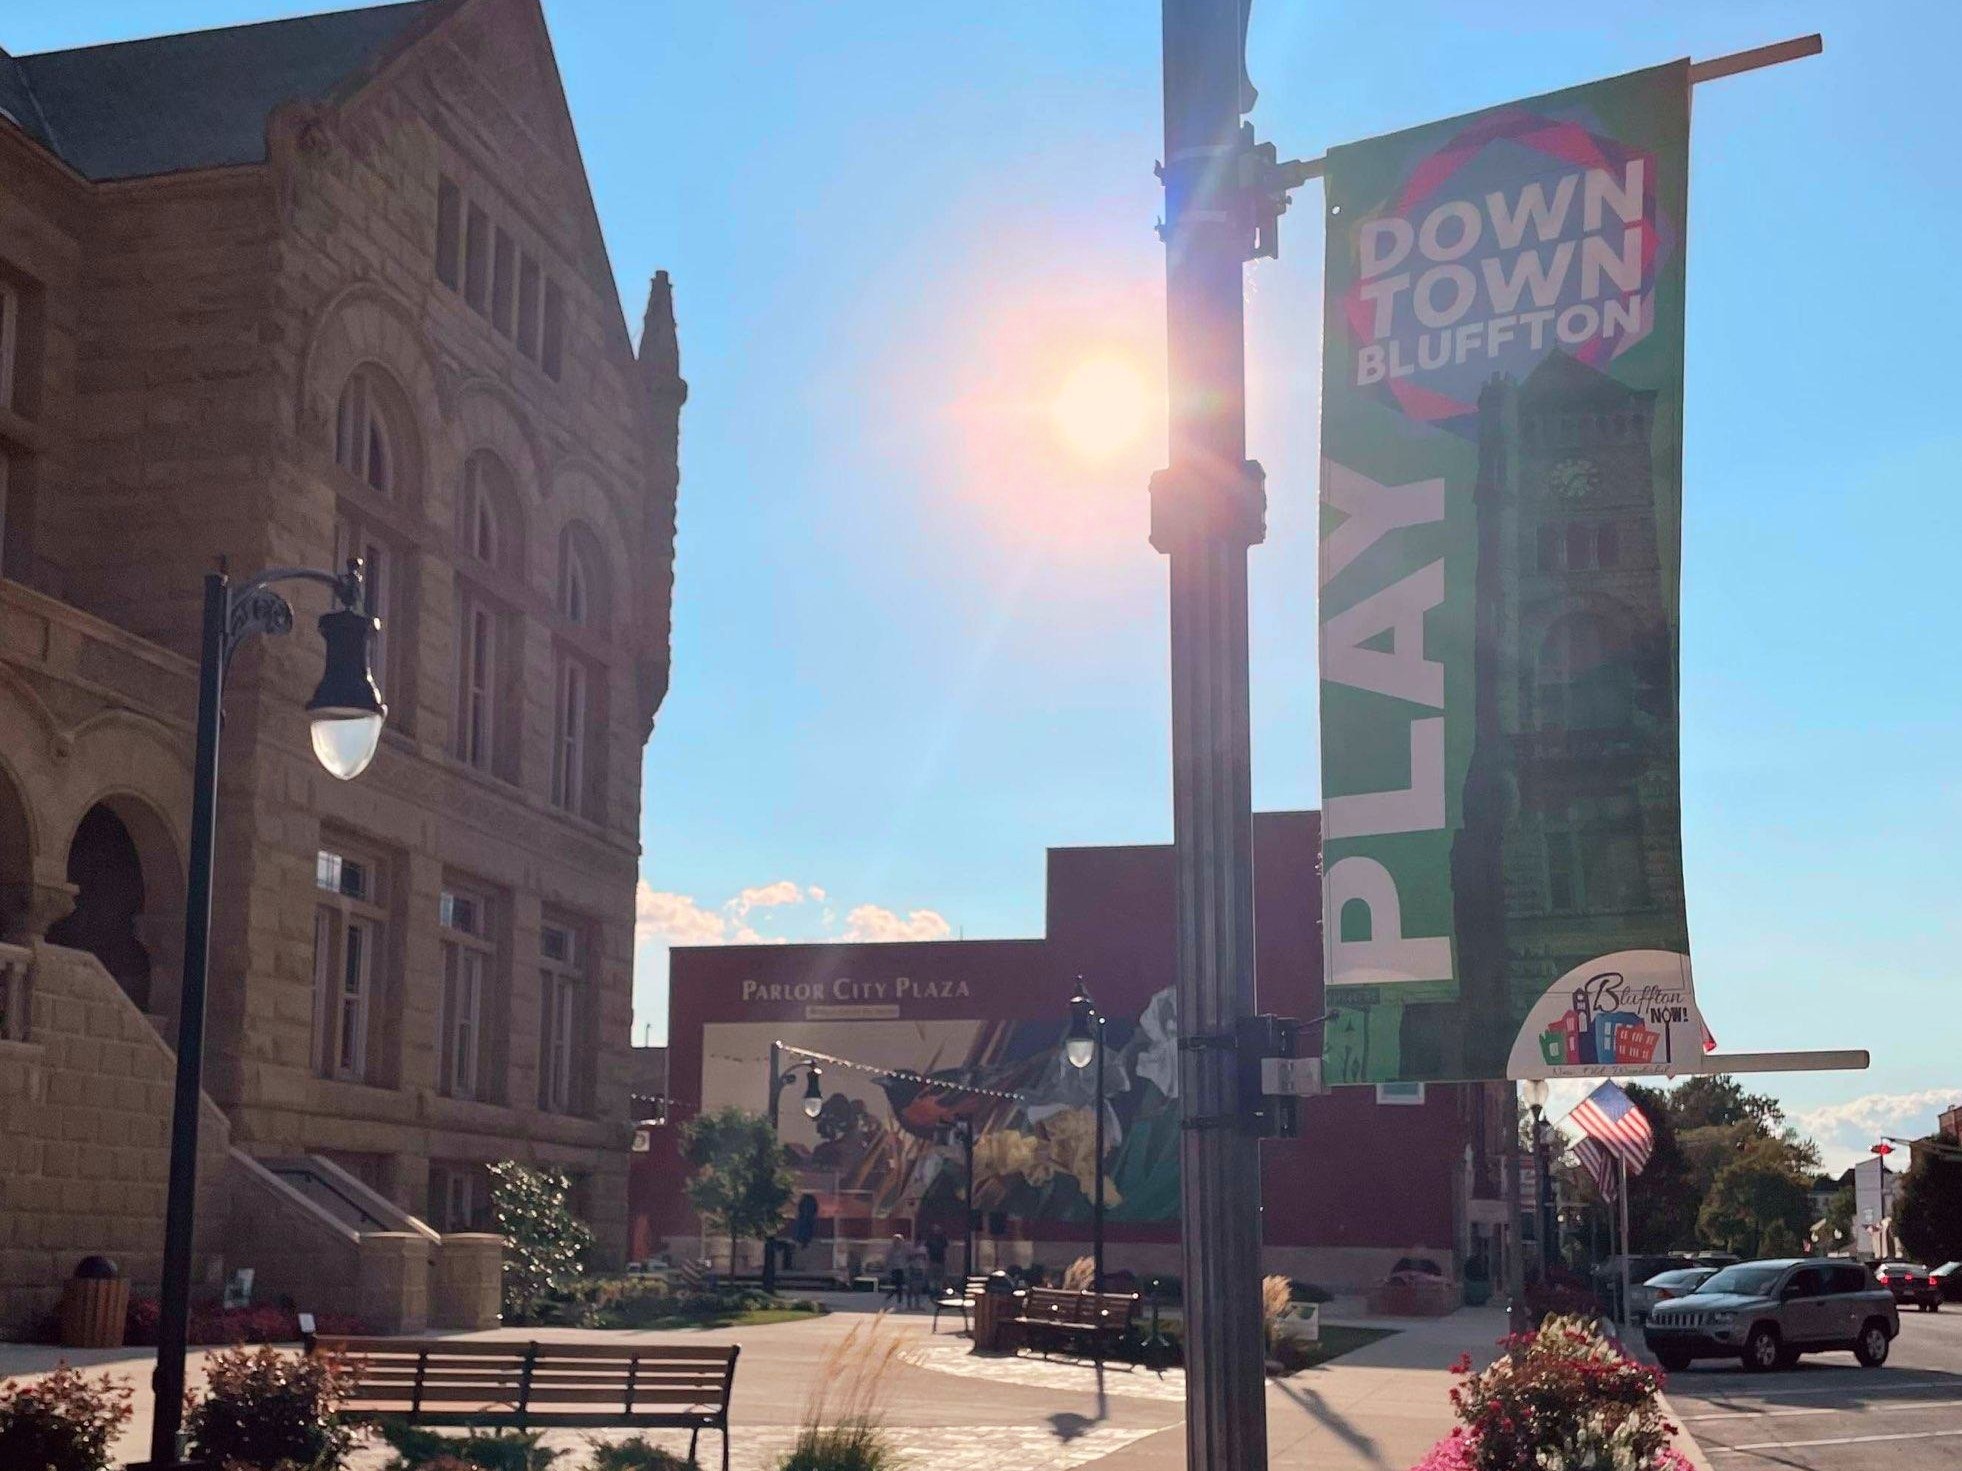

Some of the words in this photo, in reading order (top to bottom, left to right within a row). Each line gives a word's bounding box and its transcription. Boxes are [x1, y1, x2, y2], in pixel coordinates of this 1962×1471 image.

[1360, 158, 1644, 280] DOWN
[1360, 226, 1642, 340] TOWN
[1357, 294, 1642, 386] BLUFFTON
[1320, 457, 1453, 985] PLAY
[742, 979, 825, 1001] PARLOR
[832, 977, 887, 1000] CITY
[896, 976, 970, 999] PLAZA
[1585, 972, 1684, 1016] Bluffton
[1651, 1005, 1689, 1024] NOW!
